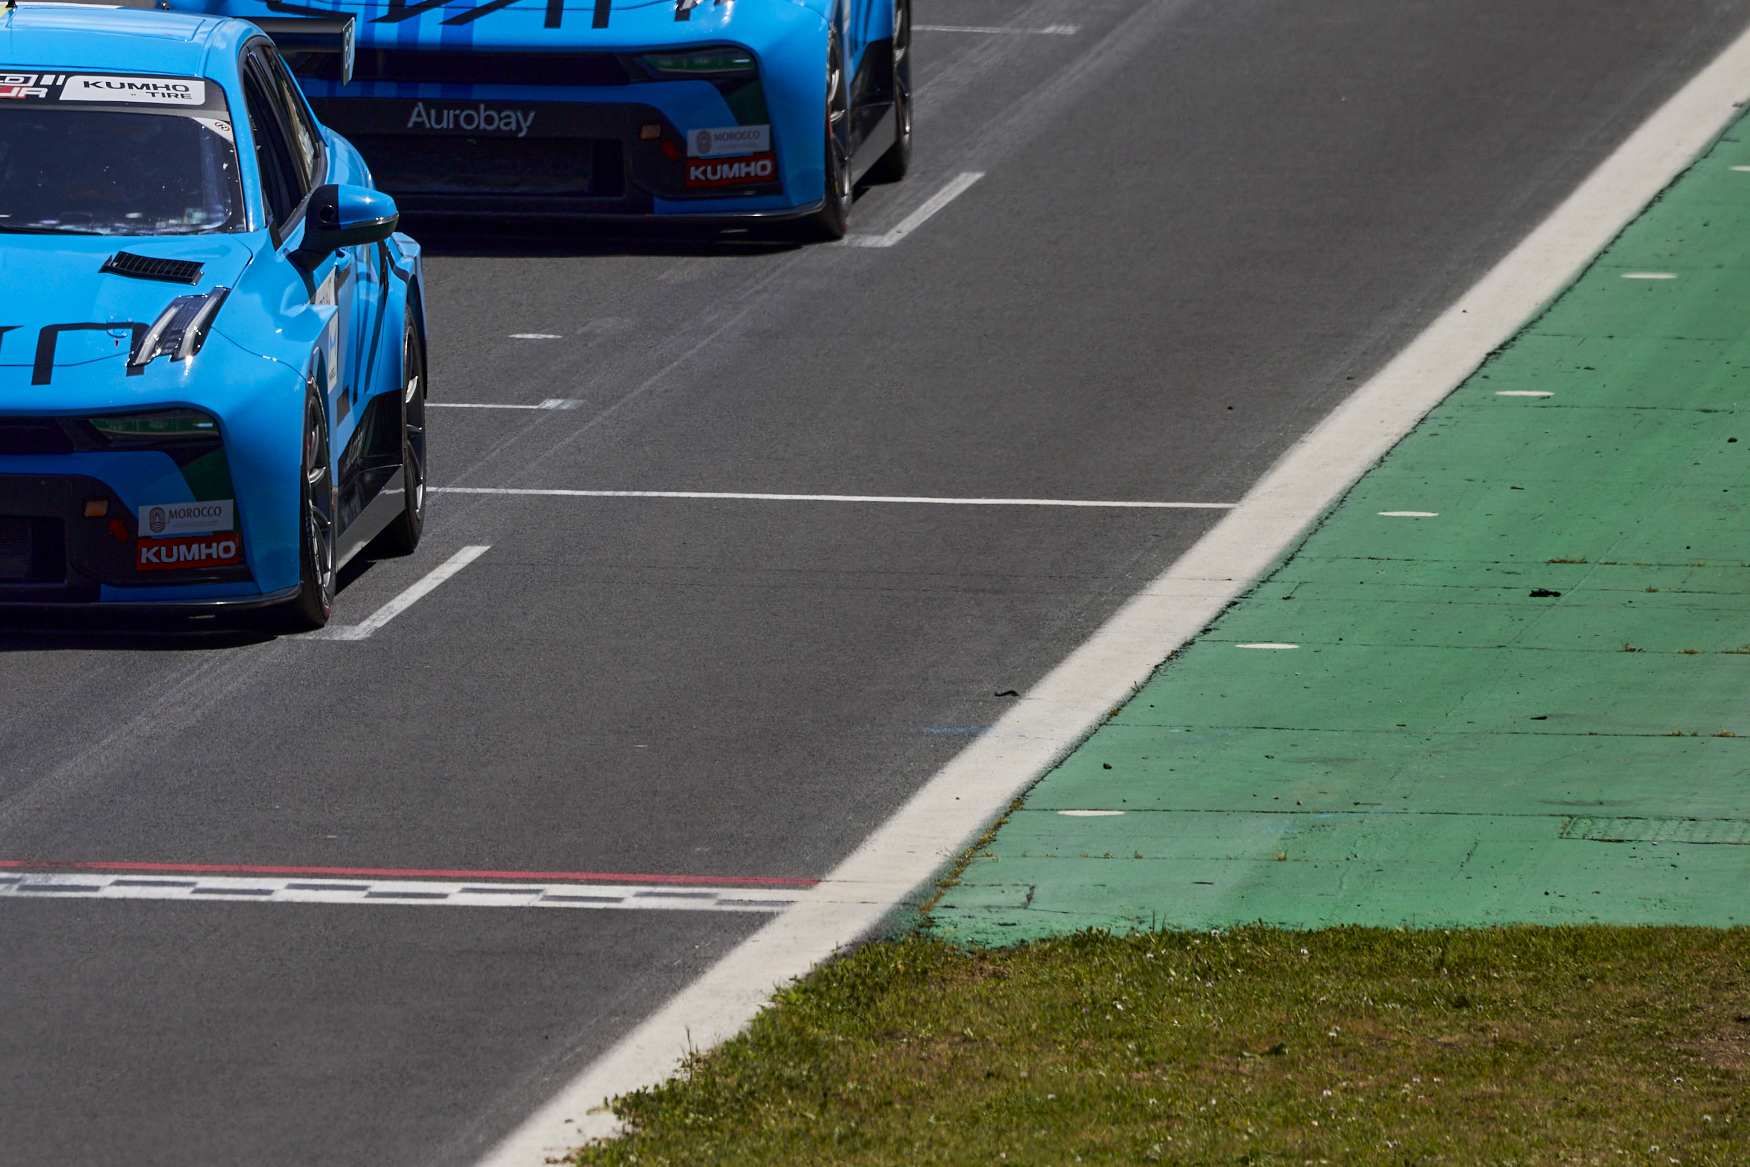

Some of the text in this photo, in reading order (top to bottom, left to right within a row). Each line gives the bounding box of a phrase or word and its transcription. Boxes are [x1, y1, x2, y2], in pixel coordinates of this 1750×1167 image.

[83, 80, 190, 92] KUMHO
[145, 91, 193, 100] TIRE
[407, 103, 535, 137] Aurobay
[690, 160, 773, 181] KUMHO
[168, 505, 222, 519] MOROCCO
[140, 540, 236, 564] KUMHO
